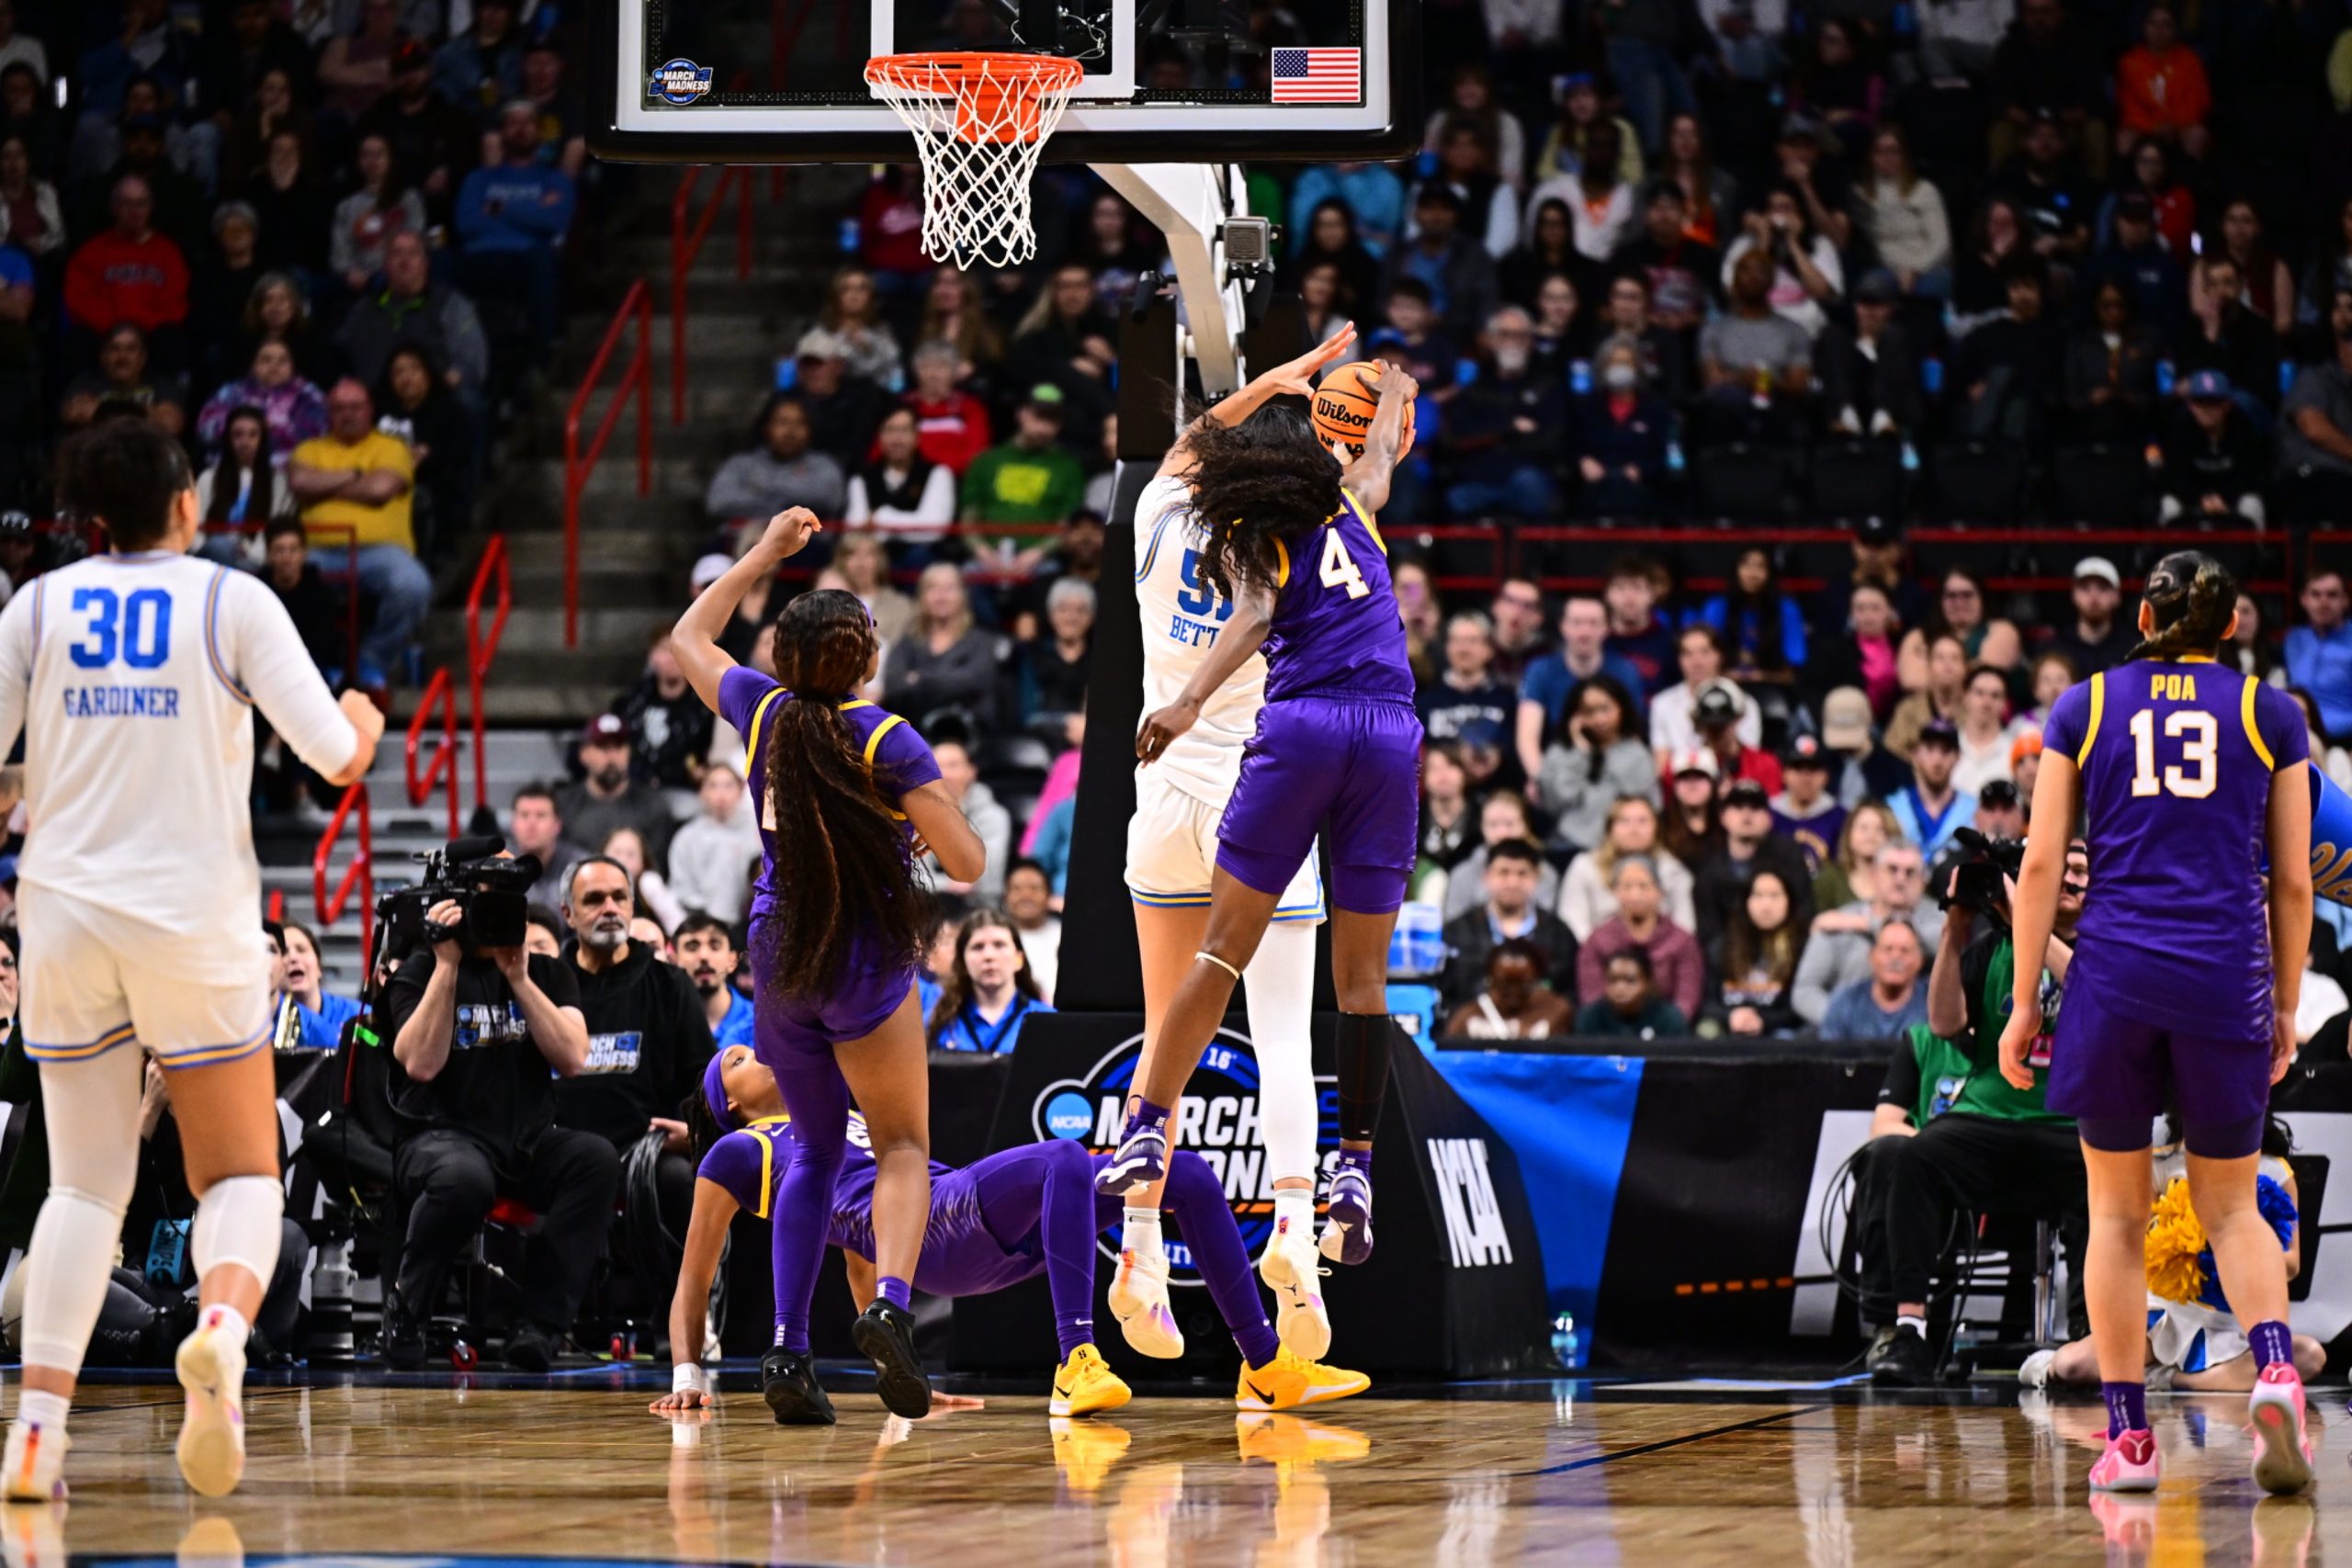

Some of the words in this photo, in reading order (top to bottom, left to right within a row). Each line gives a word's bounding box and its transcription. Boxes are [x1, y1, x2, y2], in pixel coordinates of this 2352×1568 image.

[663, 71, 695, 81] MARCH
[667, 80, 710, 90] MADNESS
[1319, 527, 1371, 600] 4
[70, 588, 172, 669] 30
[1169, 615, 1220, 649] BETT
[63, 686, 179, 717] GARDINER
[2151, 673, 2197, 701] POA
[2130, 708, 2218, 799] 13
[583, 1051, 638, 1068] ADNESS
[1051, 1115, 1091, 1130] NCAA
